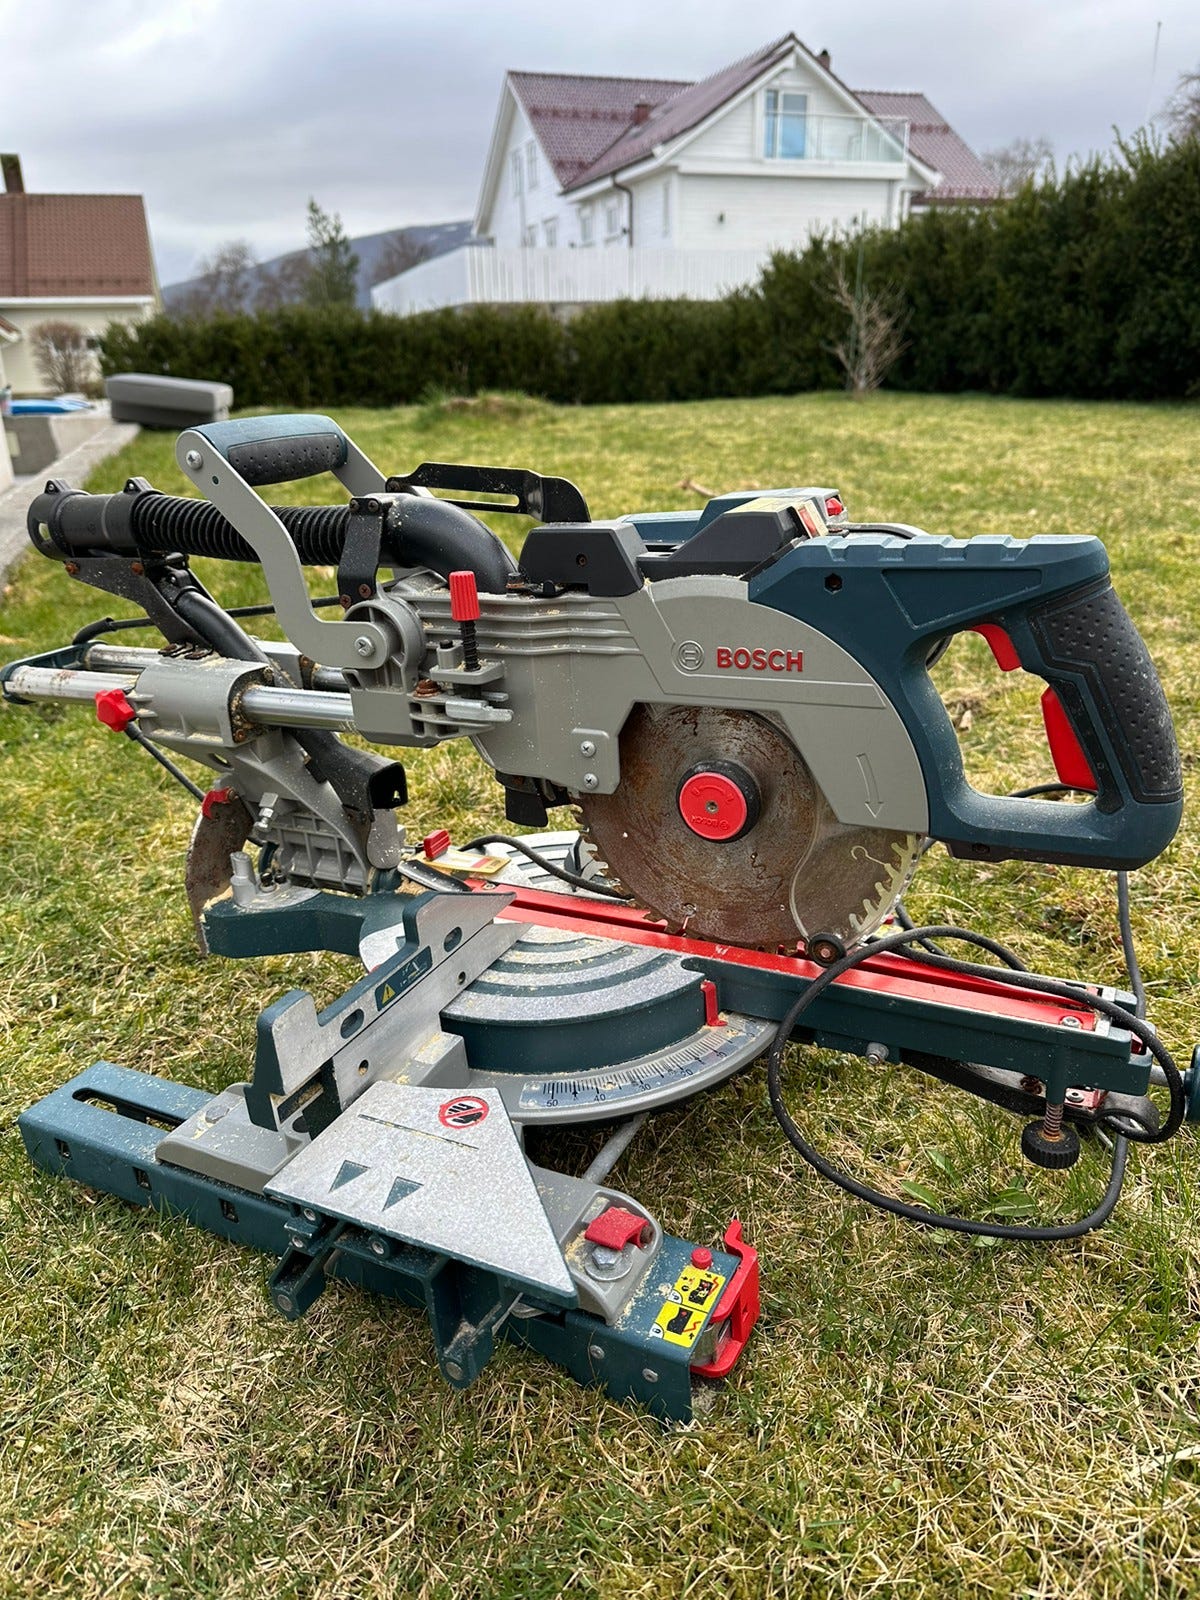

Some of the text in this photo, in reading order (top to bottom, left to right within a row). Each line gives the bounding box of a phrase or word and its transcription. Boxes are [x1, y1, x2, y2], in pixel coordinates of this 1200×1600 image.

[716, 646, 804, 672] BOSCH
[546, 1099, 559, 1108] 50
[594, 1093, 606, 1102] 40
[640, 1083, 652, 1092] 30
